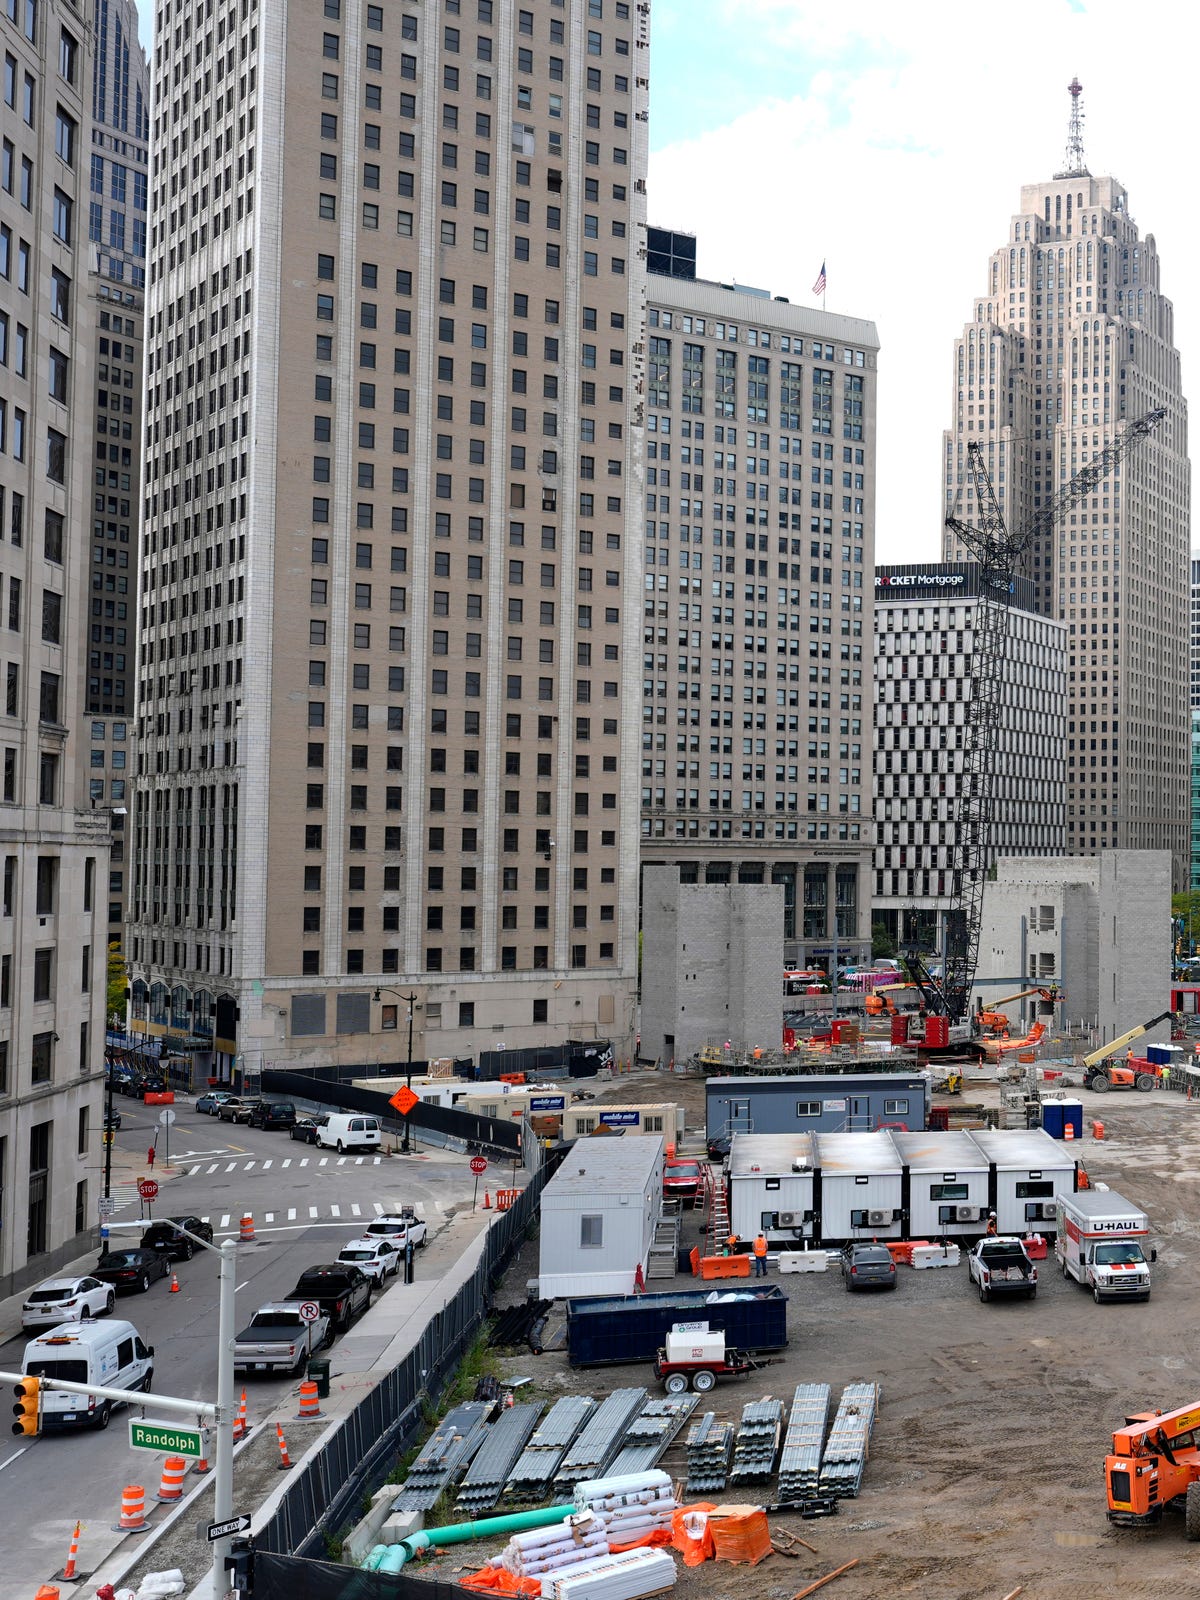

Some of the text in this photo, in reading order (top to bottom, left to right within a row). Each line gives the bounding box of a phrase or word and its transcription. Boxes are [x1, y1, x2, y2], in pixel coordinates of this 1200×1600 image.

[874, 575, 964, 586] ROCKET Mortgage
[602, 1113, 622, 1121] mobile
[470, 1161, 487, 1169] STOP
[140, 1185, 158, 1193] STOP
[1093, 1221, 1140, 1231] U-HAUL
[136, 1429, 195, 1450] Randolph
[1113, 1462, 1127, 1470] JLG
[211, 1522, 240, 1536] ONE WAY
